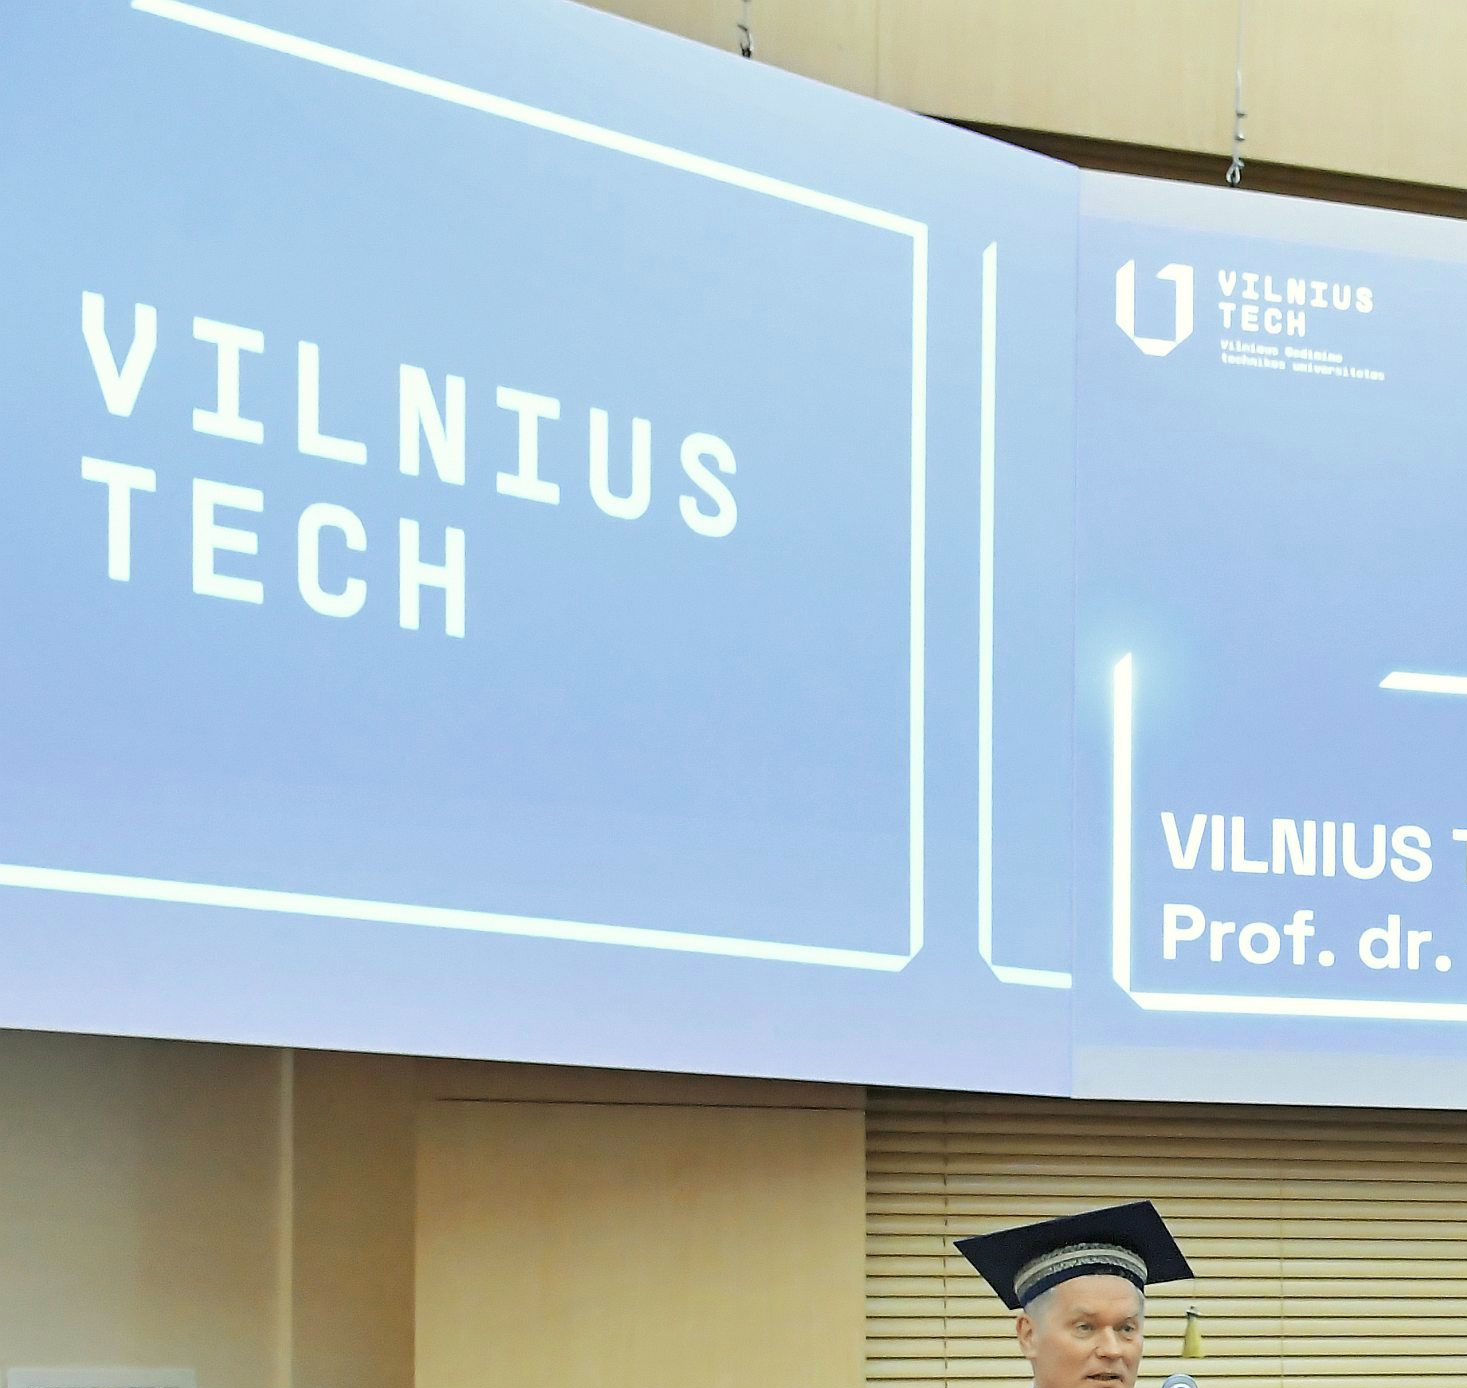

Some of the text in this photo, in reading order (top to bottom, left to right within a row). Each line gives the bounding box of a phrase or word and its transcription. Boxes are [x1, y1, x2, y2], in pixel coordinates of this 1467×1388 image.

[1218, 270, 1374, 314] VILNIUS
[1218, 302, 1307, 338] TECH
[82, 291, 738, 539] VILNIUS
[81, 457, 466, 638] TECH
[1161, 812, 1433, 882] VILNIUS
[1162, 903, 1335, 967] Prof.
[1359, 914, 1452, 972] dr.
